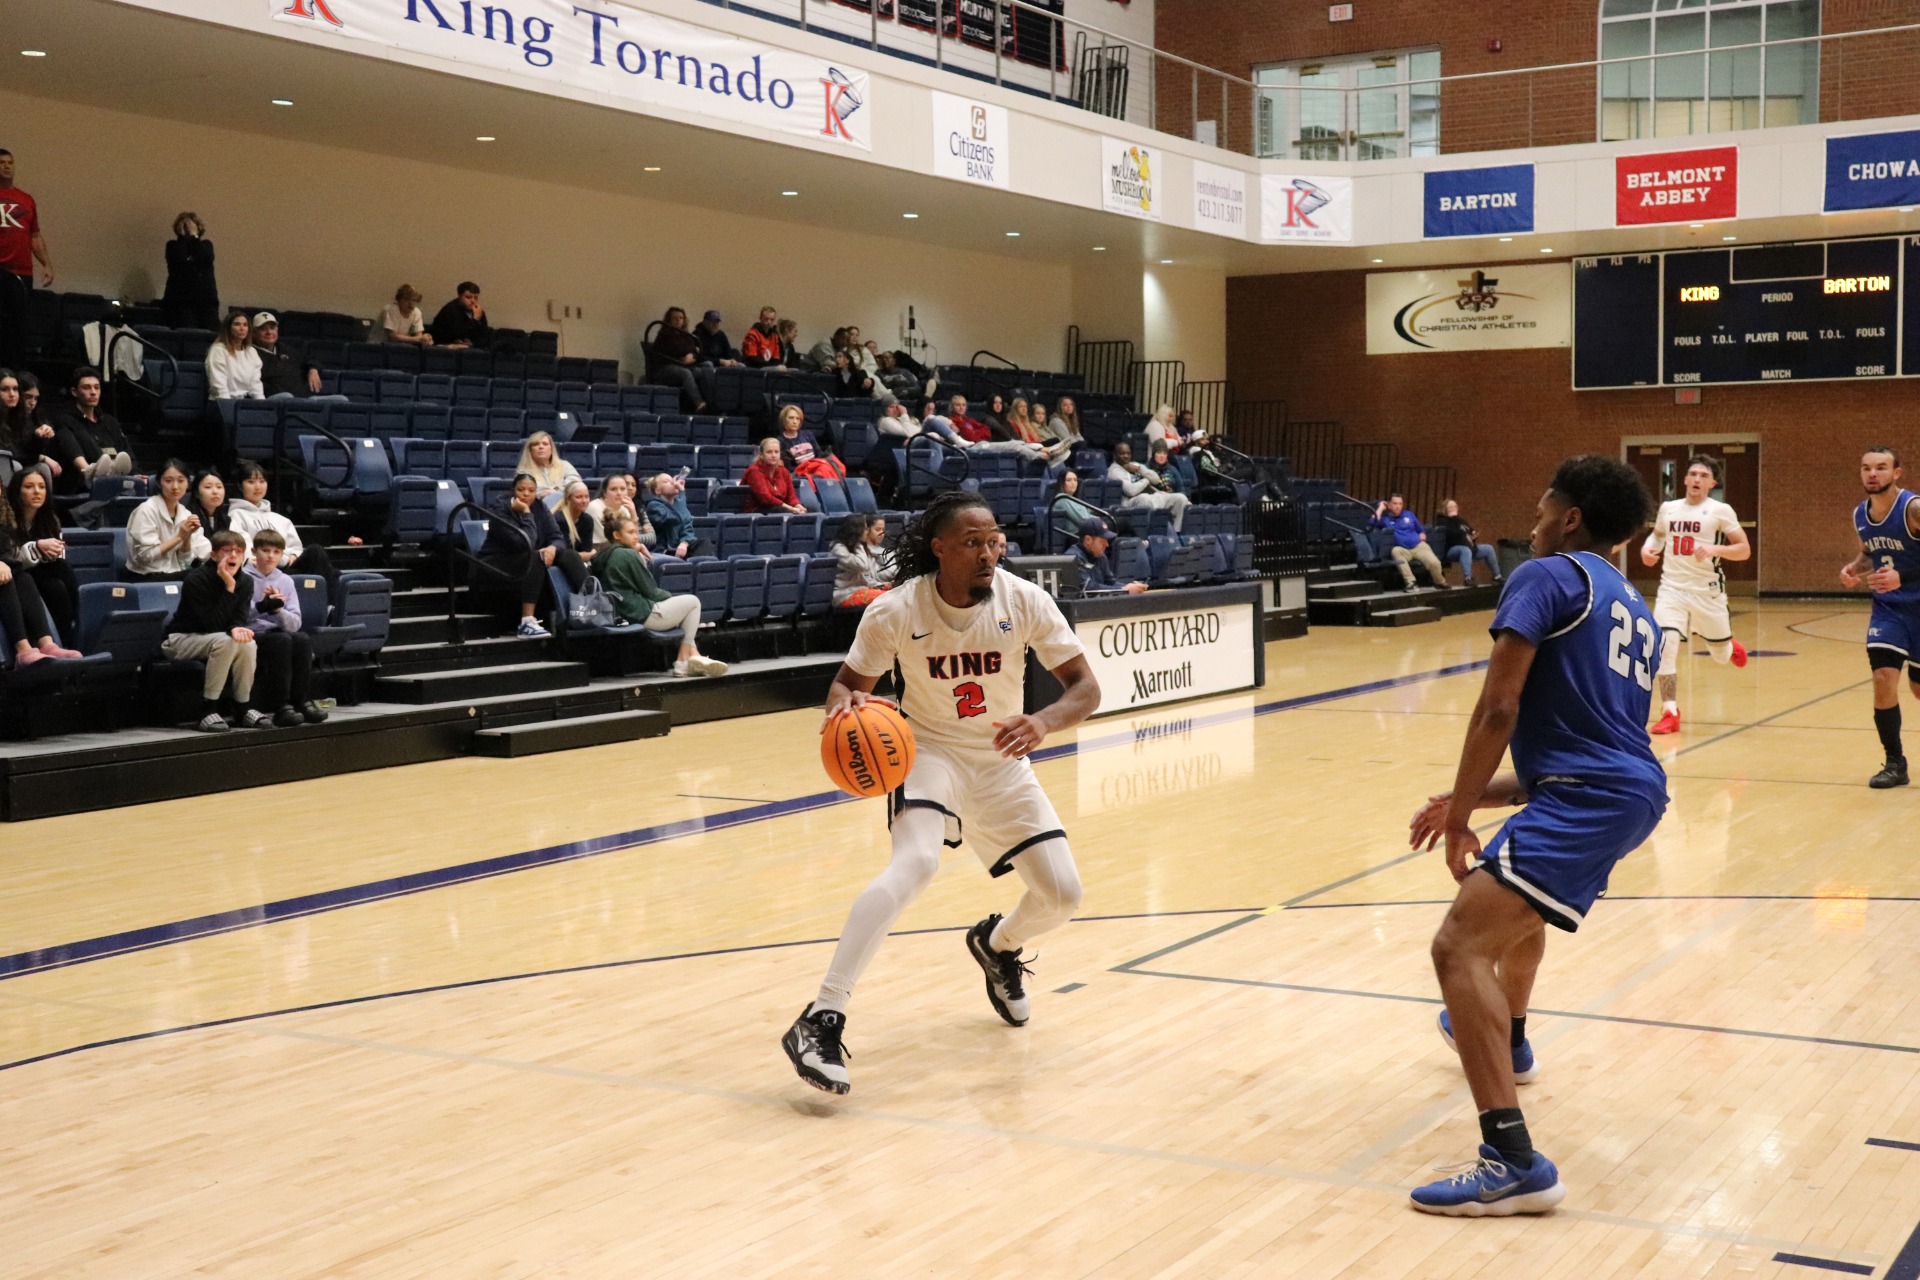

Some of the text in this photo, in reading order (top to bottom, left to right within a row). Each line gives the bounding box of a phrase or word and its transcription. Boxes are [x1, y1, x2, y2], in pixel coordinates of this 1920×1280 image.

[573, 6, 795, 109] Tornado
[949, 131, 995, 164] Citizens
[967, 161, 994, 182] BANK
[1626, 166, 1726, 188] BELMONT
[1848, 159, 1920, 180] CHOWA
[1440, 192, 1517, 211] BARTON
[1640, 186, 1711, 207] ABBEY
[0, 203, 24, 228] K
[1681, 286, 1720, 302] KING
[1824, 276, 1890, 294] BARTON
[1761, 292, 1794, 303] PERIOD
[1419, 321, 1537, 333] CHRISTIAN ATHLETES
[1440, 314, 1514, 324] FELLOWSHIP OF
[1674, 327, 1885, 346] FOULS T.O.L. PLAYER FOUL T.O.L. FOULS
[1673, 365, 1885, 383] SCORE MATCH SCORE
[1669, 521, 1701, 533] KING
[1673, 535, 1695, 556] 10
[1099, 612, 1220, 658] COURTYARD
[1608, 600, 1655, 692] 23
[926, 651, 1002, 680] KING
[1131, 661, 1192, 703] Marriott
[953, 682, 987, 719] 2
[847, 729, 876, 790] Wilson
